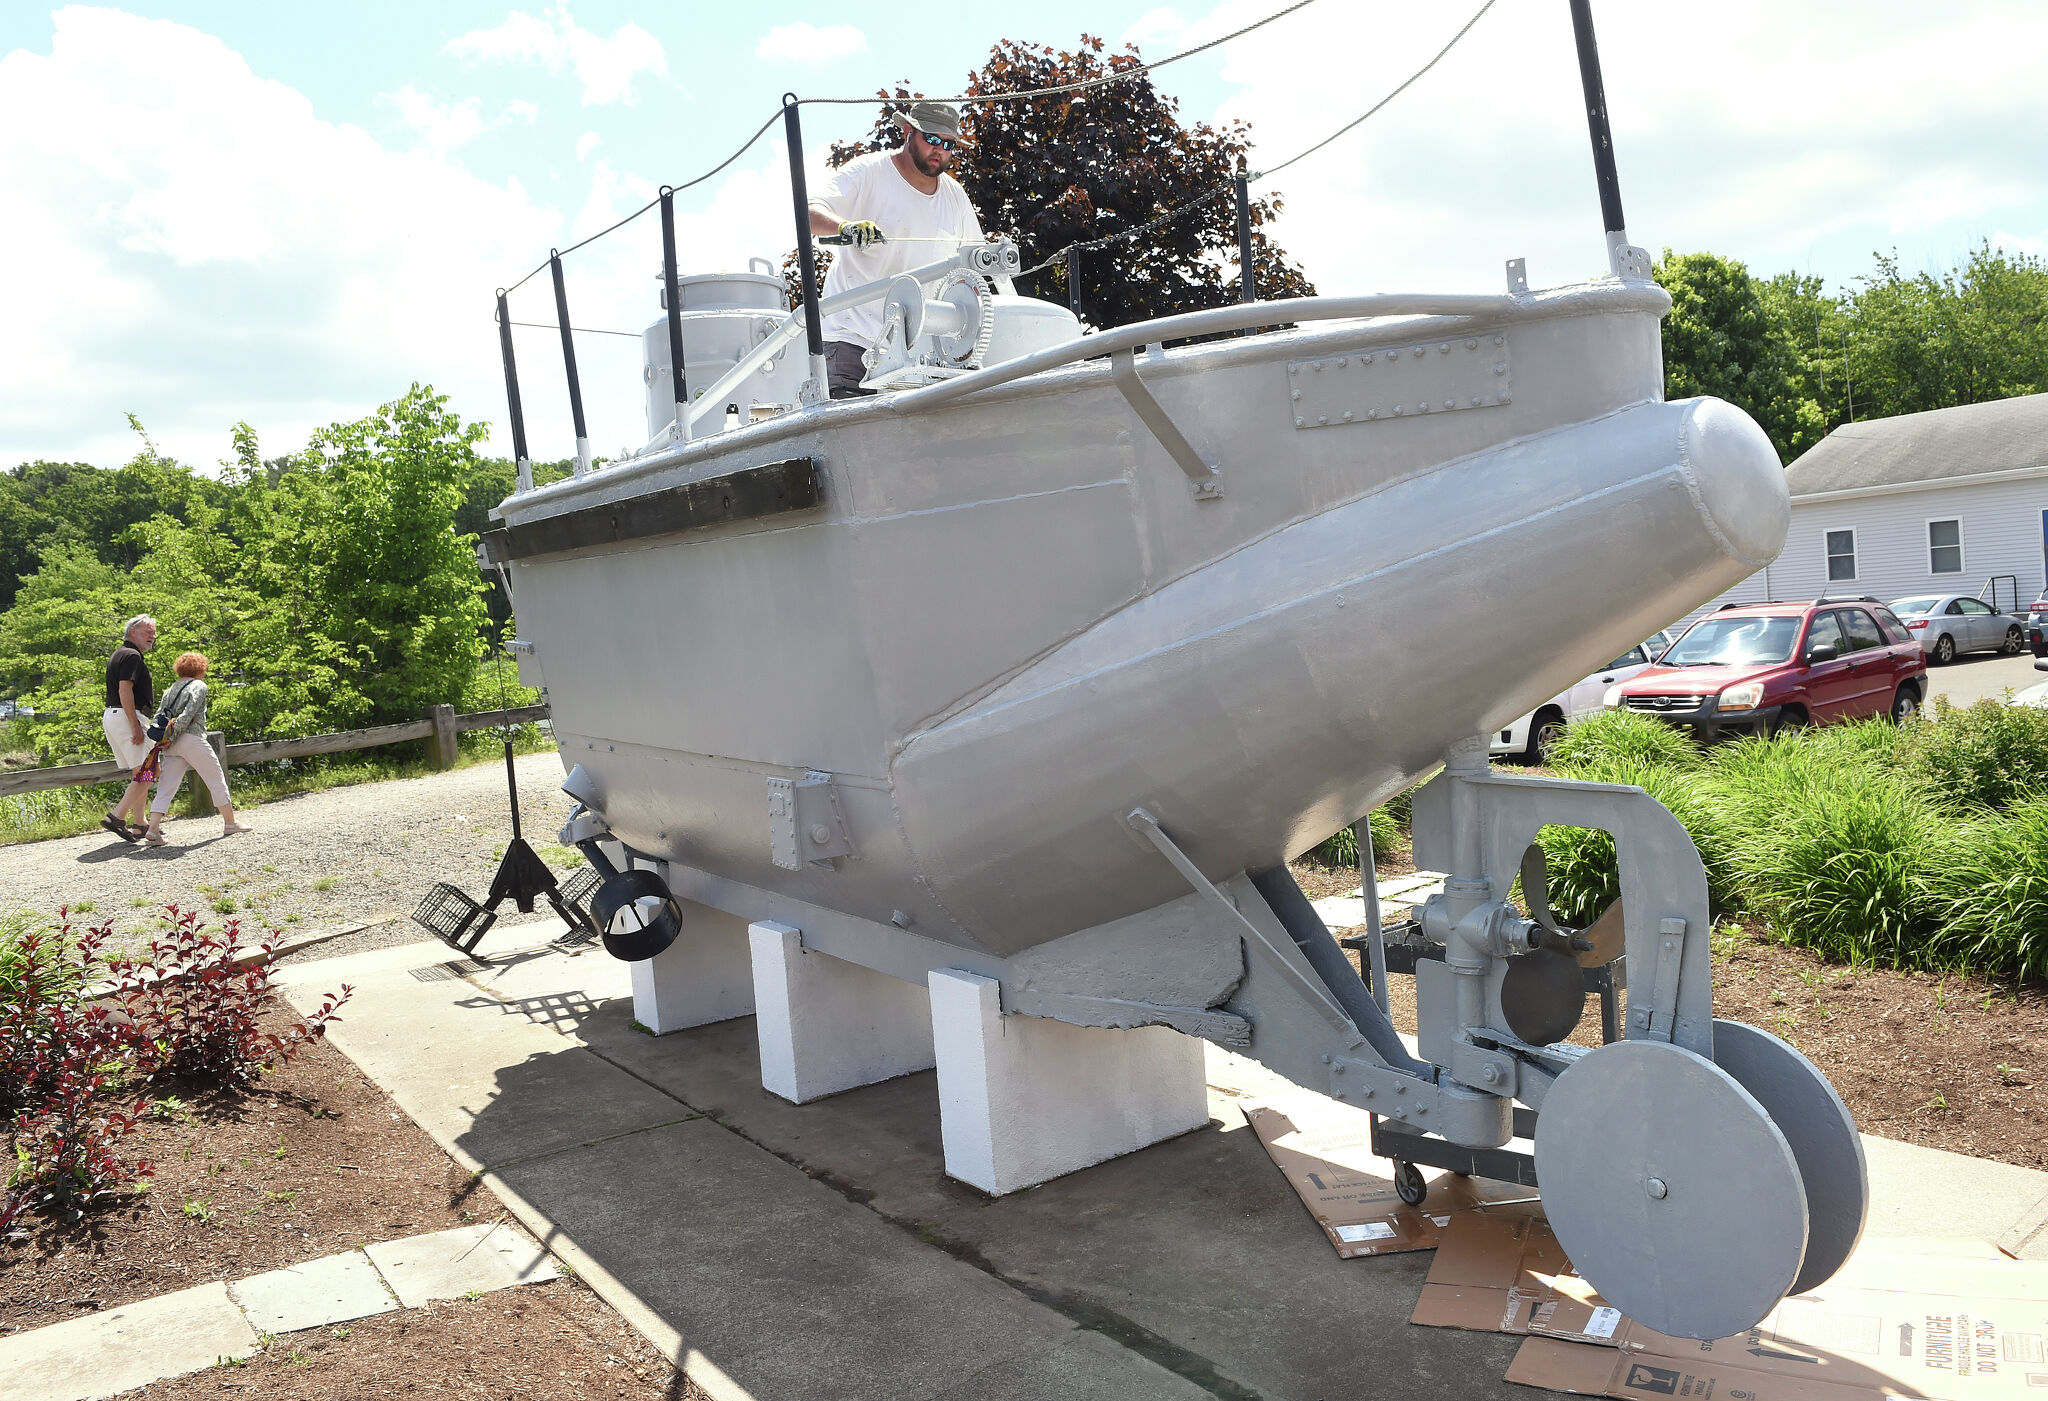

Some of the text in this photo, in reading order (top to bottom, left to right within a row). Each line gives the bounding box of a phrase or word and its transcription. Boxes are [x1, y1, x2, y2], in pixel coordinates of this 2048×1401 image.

[1926, 1316, 1953, 1369] FURNITURE
[1975, 1319, 1998, 1373] DO NOT DROP
[1958, 1355, 1971, 1376] FRAGILE
[1680, 1374, 1695, 1397] FURNITURE
